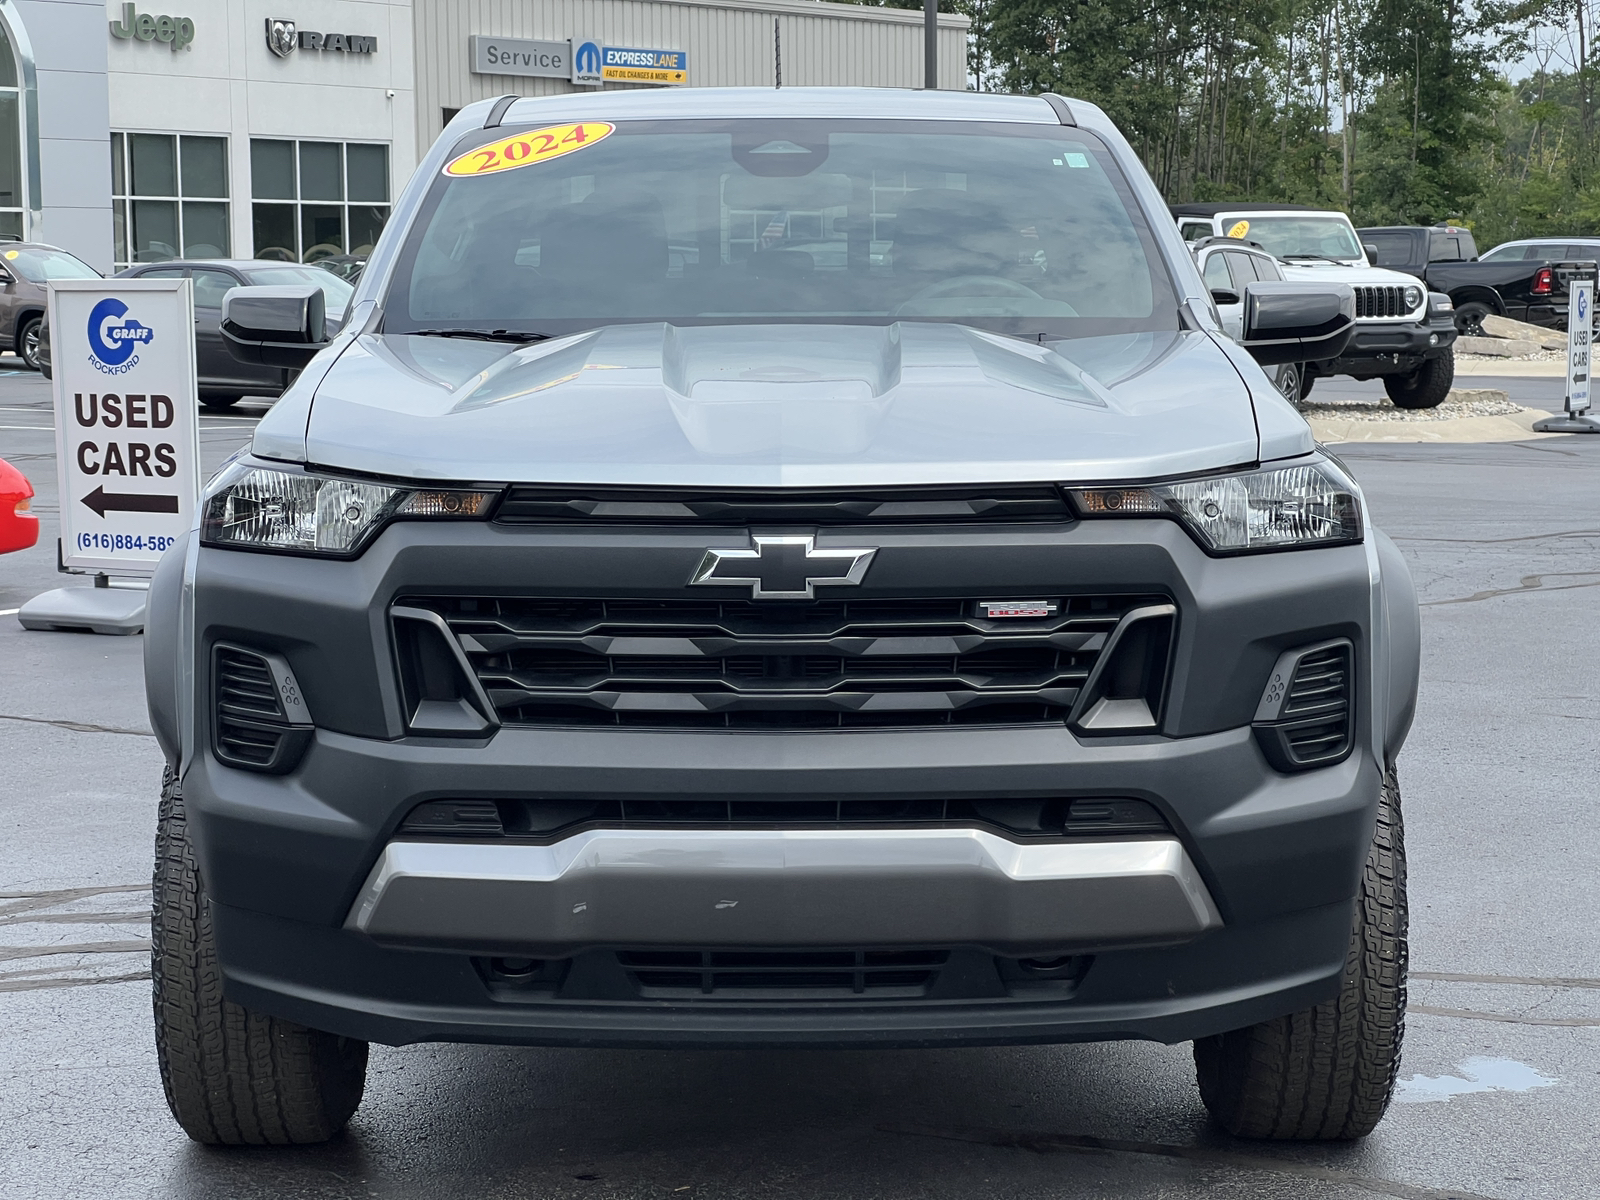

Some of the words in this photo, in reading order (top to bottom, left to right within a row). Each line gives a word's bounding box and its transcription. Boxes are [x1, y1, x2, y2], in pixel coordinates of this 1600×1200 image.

[109, 2, 195, 50] Jeep
[297, 31, 378, 54] RAM
[487, 45, 562, 69] Service
[606, 70, 618, 78] FAST
[627, 71, 649, 80] CHANGES
[655, 73, 669, 81] MORE
[472, 125, 589, 172] 2024
[112, 328, 149, 339] GRAFF
[1573, 331, 1588, 346] USED
[88, 354, 140, 376] ROCKFORD
[1572, 351, 1588, 367] CARS
[74, 393, 175, 428] USED
[77, 441, 177, 478] CARS
